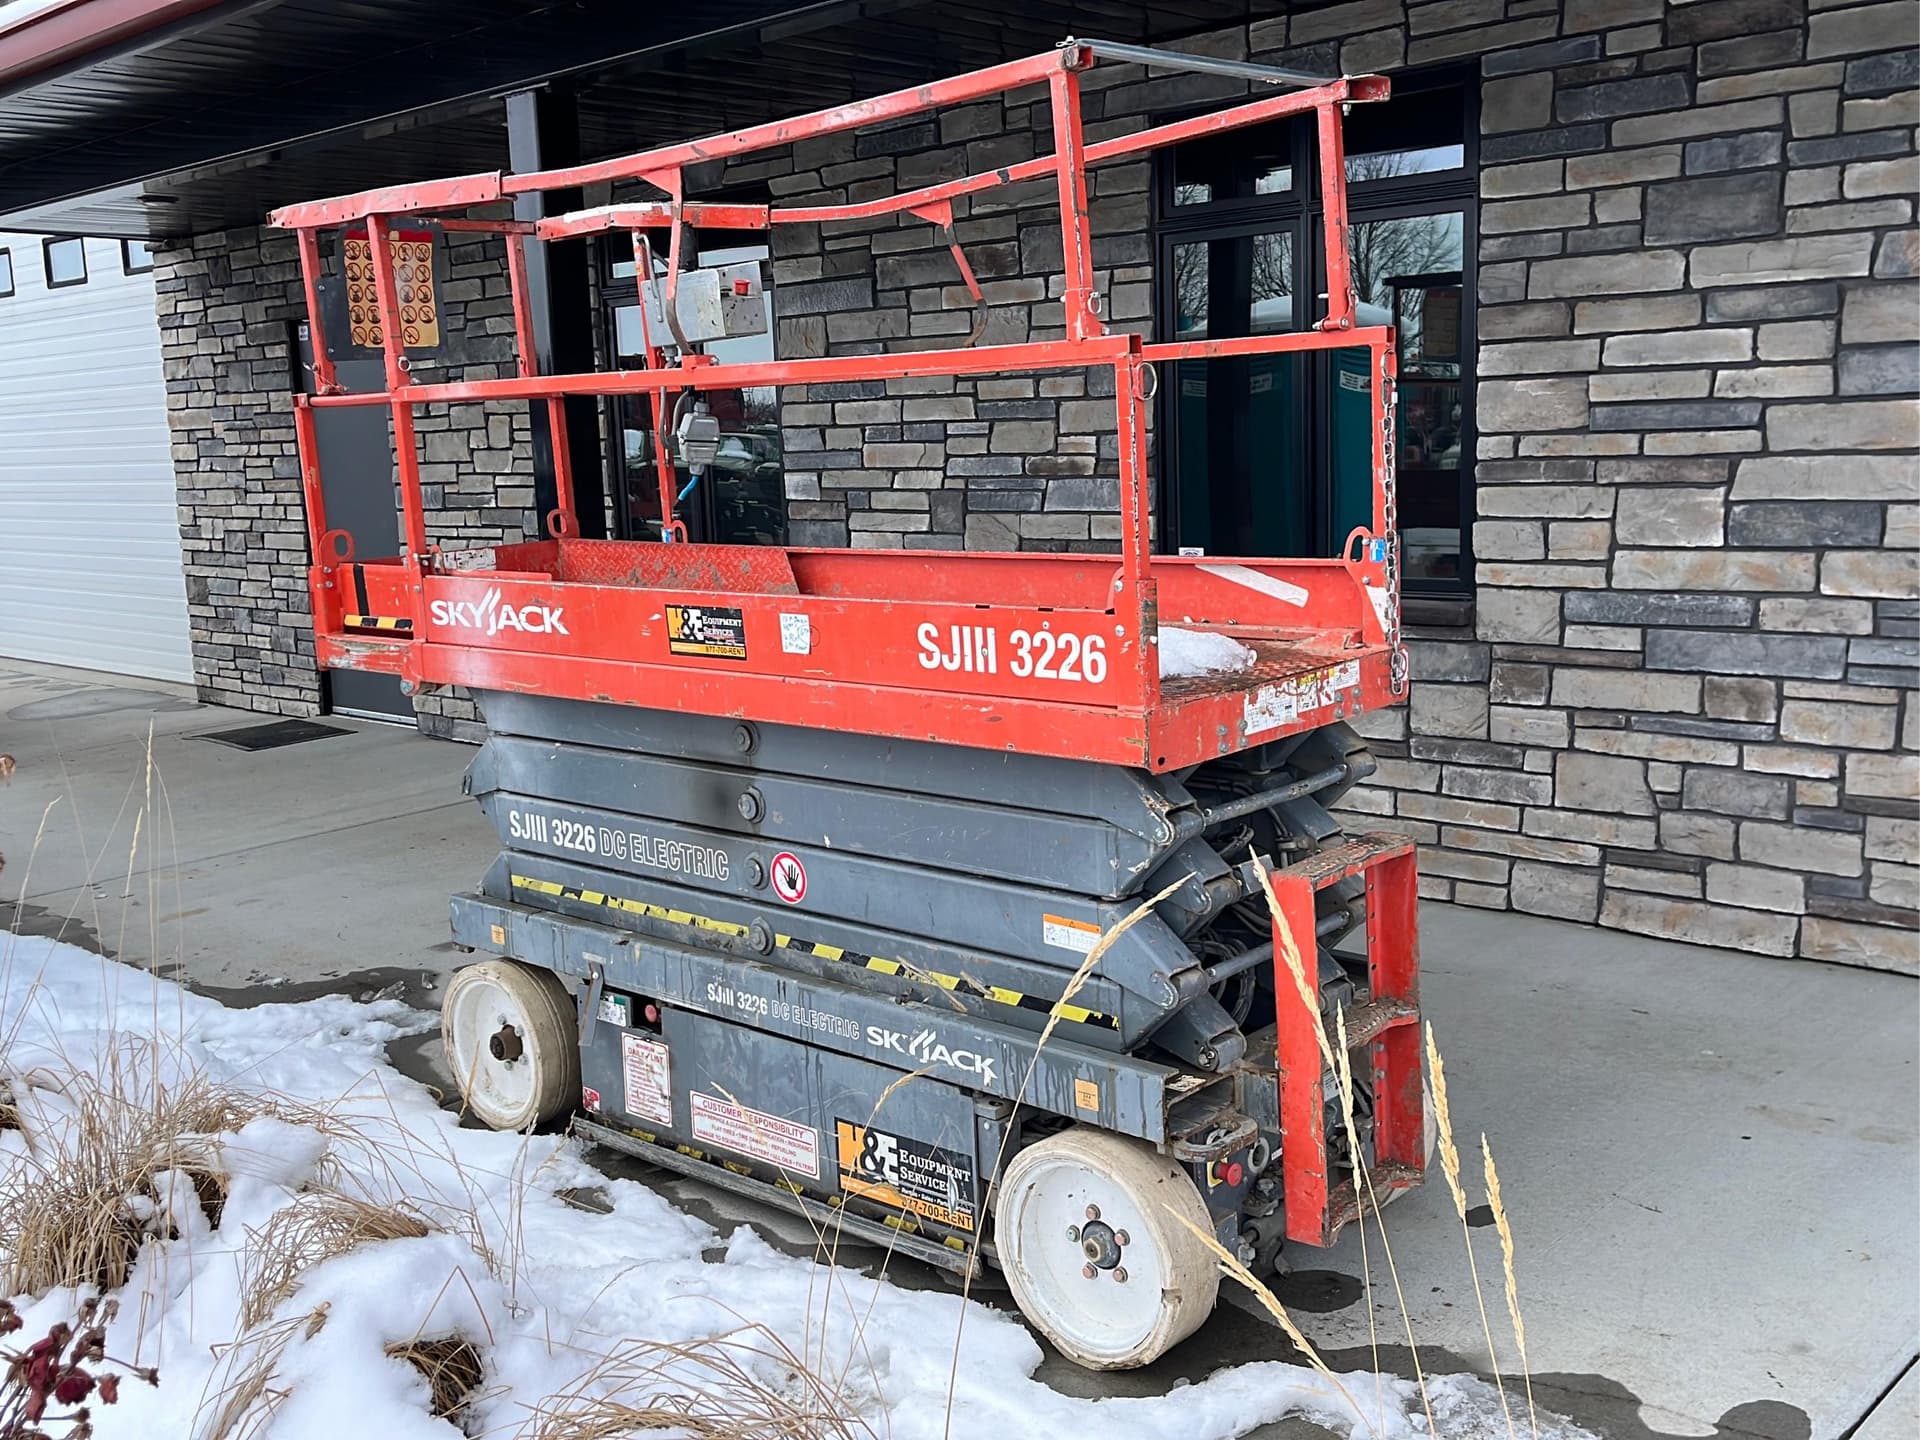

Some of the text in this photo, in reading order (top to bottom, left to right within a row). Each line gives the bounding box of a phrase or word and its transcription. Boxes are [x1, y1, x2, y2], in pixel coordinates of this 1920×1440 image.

[431, 587, 570, 637] SKYJACK
[1009, 629, 1107, 684] 3226
[509, 809, 730, 881] SJIII 3226 DC ELECTRIC
[736, 990, 768, 1016] 3226
[771, 1000, 790, 1021] DC
[792, 1003, 860, 1041] ELECTRIC
[867, 1025, 998, 1081] SKYJACK
[702, 1099, 743, 1119] CUSTOMER
[899, 1148, 971, 1183] EQUIPMENT
[900, 1166, 949, 1193] SERVICE
